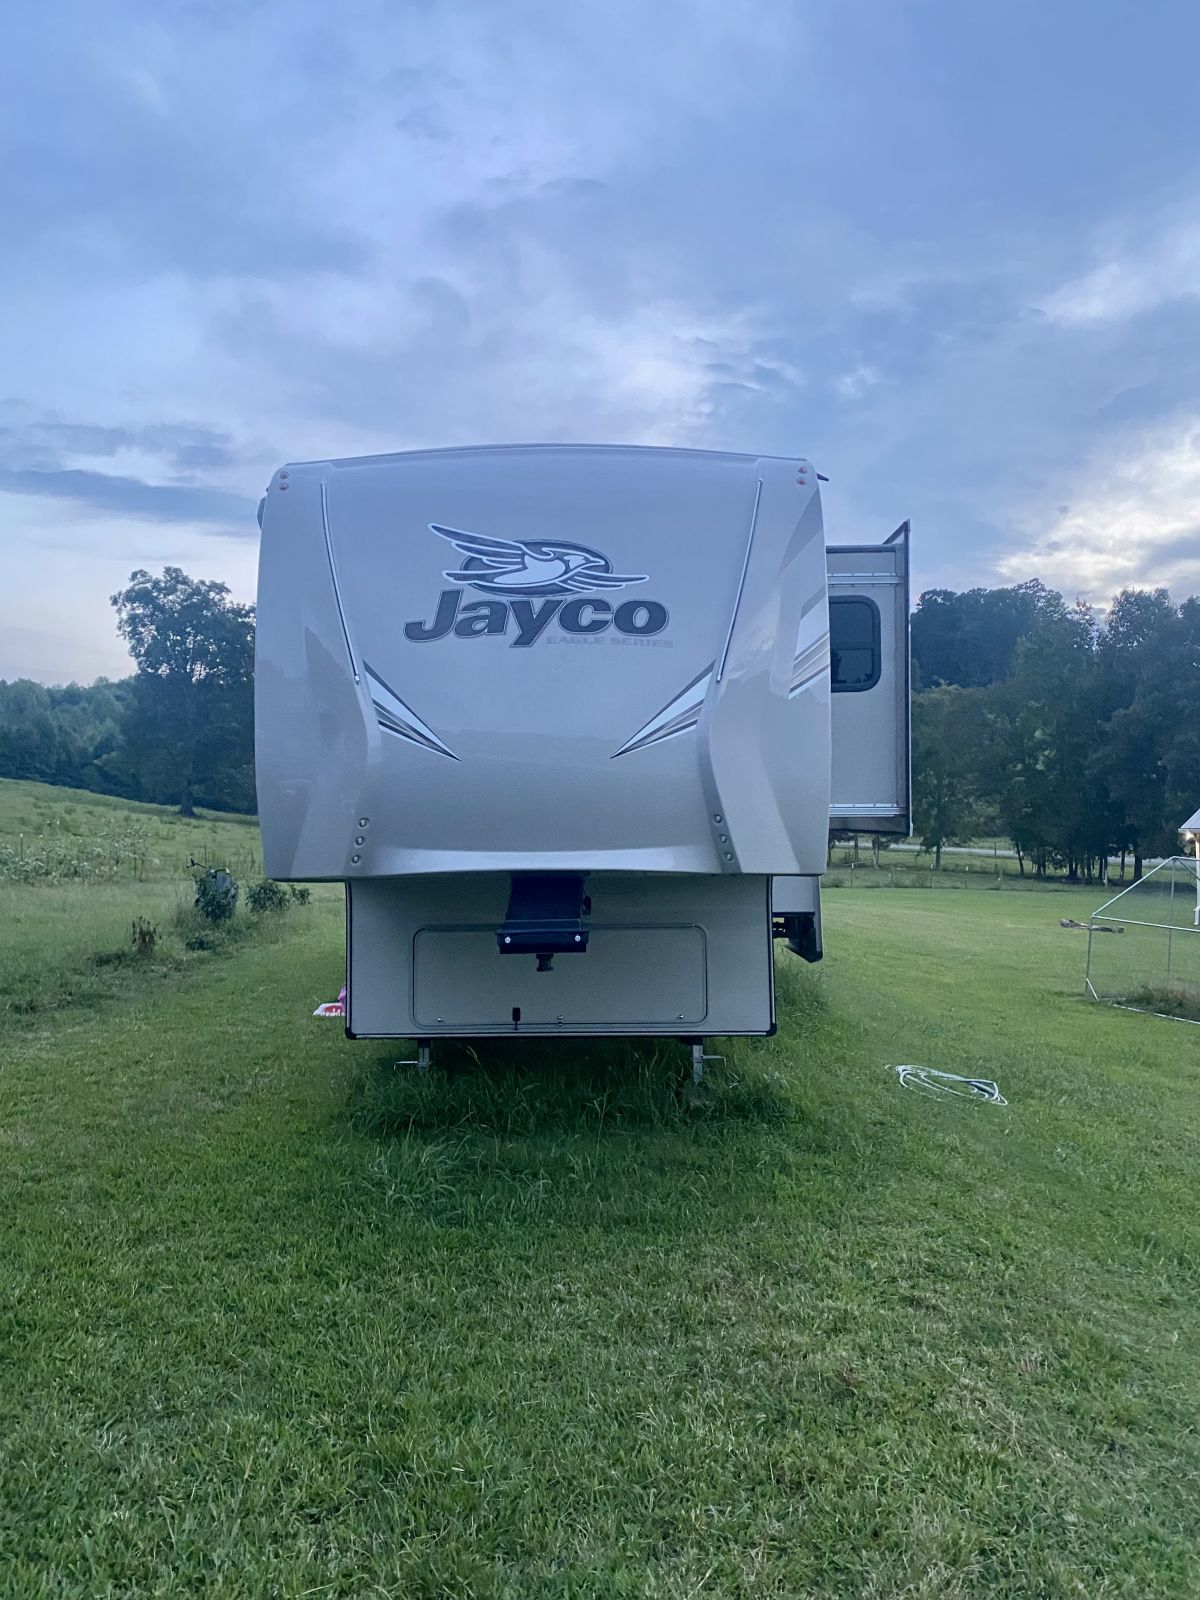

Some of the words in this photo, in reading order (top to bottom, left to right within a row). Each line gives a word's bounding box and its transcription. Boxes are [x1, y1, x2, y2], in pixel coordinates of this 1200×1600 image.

[403, 588, 669, 648] Jayco
[546, 635, 606, 646] EAGLE
[610, 636, 674, 648] SERIES
